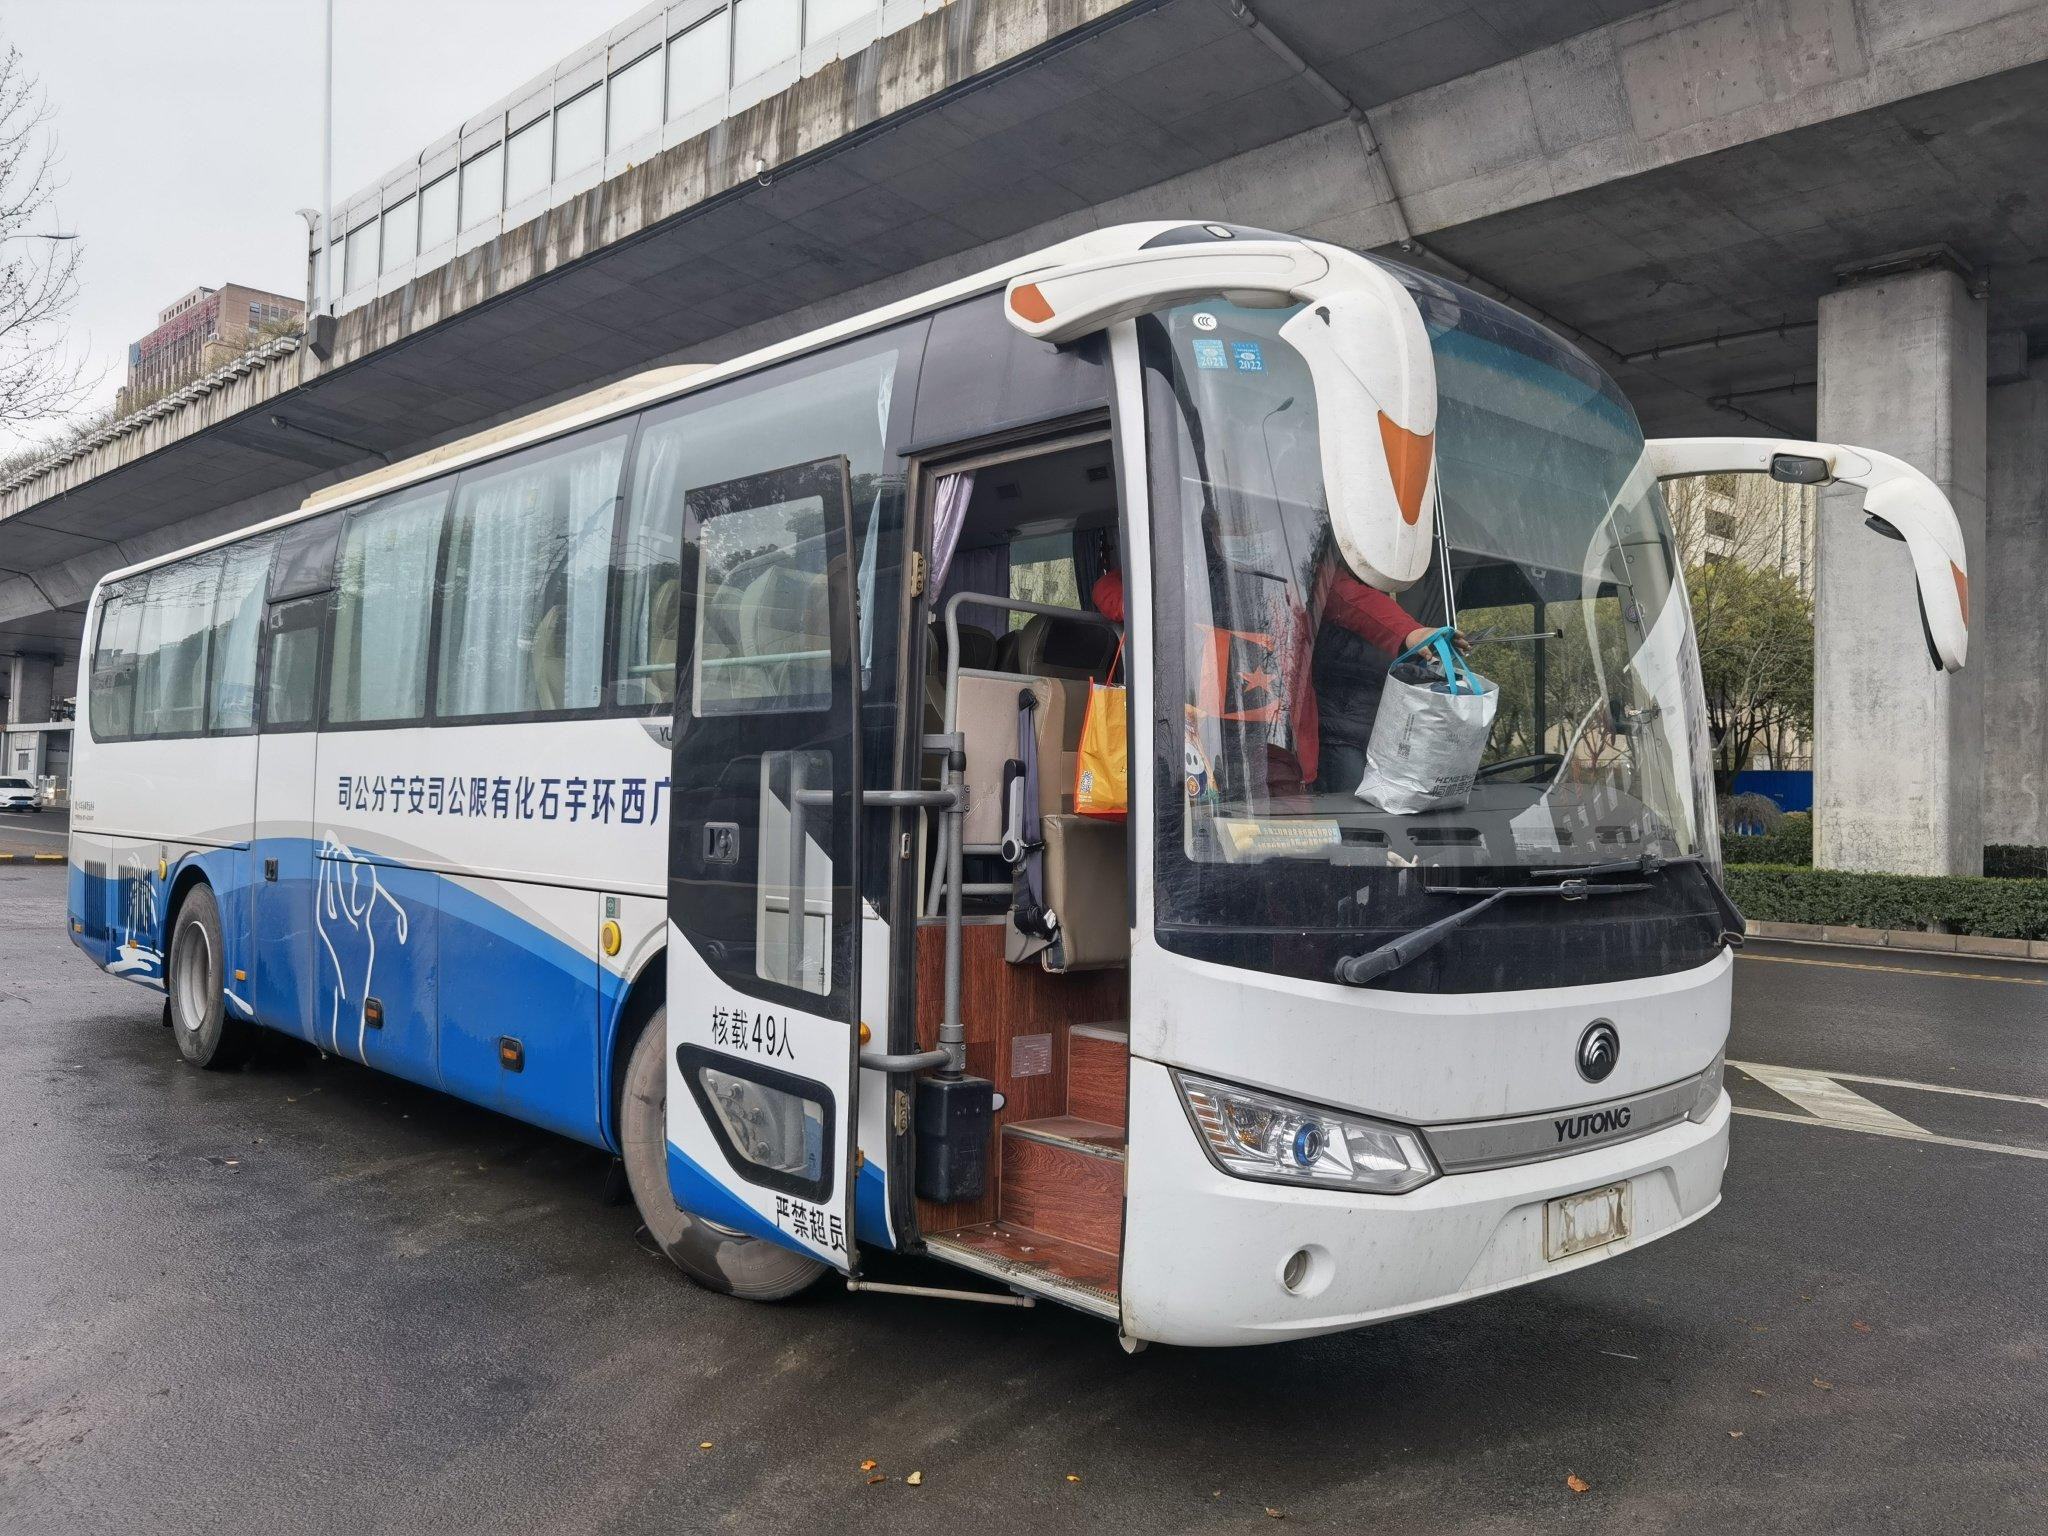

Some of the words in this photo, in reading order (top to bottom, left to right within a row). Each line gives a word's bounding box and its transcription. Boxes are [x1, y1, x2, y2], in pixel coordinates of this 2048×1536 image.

[1239, 359, 1263, 371] 2022
[1554, 1106, 1631, 1143] YUTONG
[775, 1195, 848, 1255] 严禁超员
